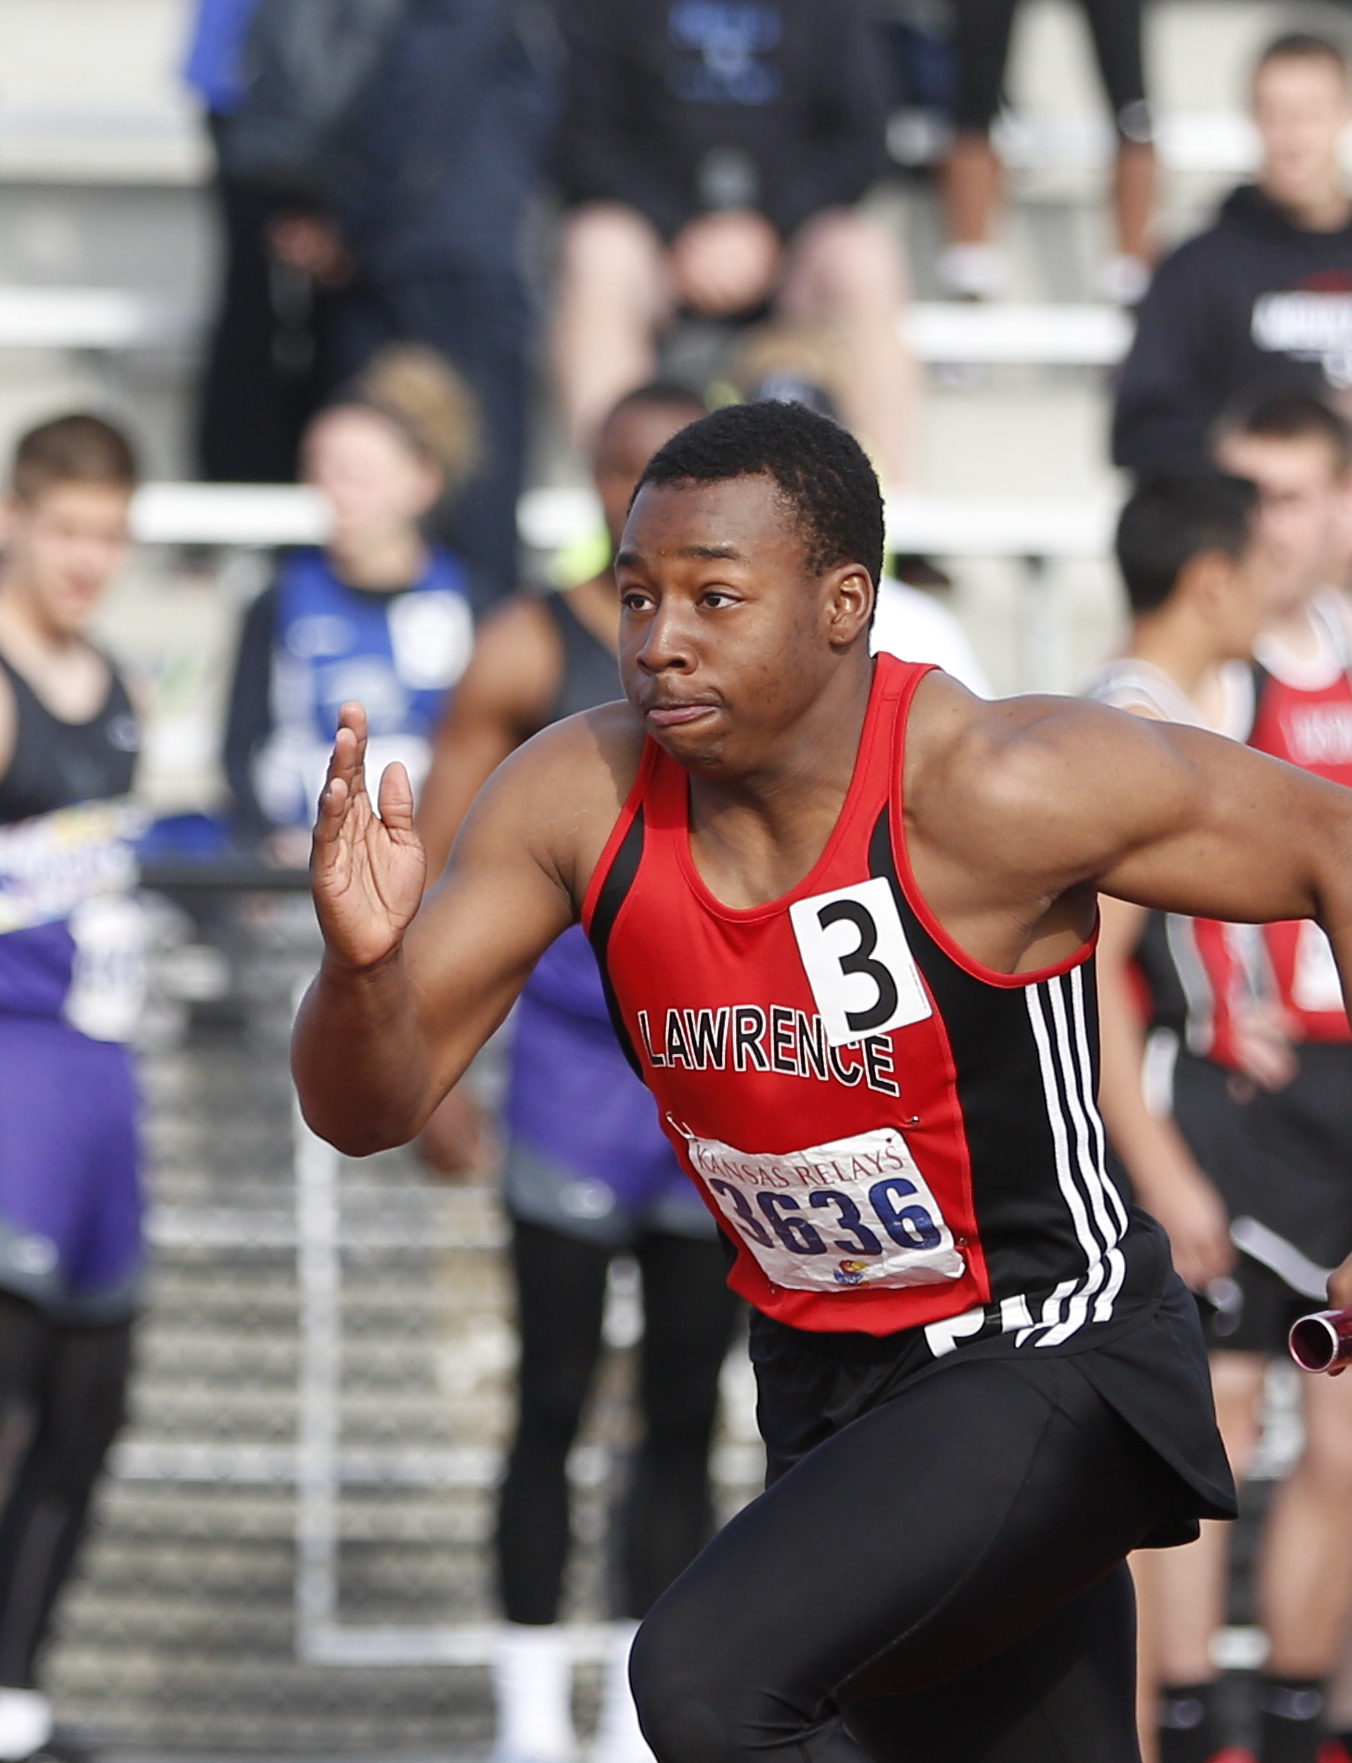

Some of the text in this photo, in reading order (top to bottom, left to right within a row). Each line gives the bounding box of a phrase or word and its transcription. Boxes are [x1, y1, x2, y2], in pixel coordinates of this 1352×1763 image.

[816, 899, 899, 1032] 3
[696, 1143, 905, 1189] KANSAS RELAYS
[708, 1177, 943, 1256] 3636
